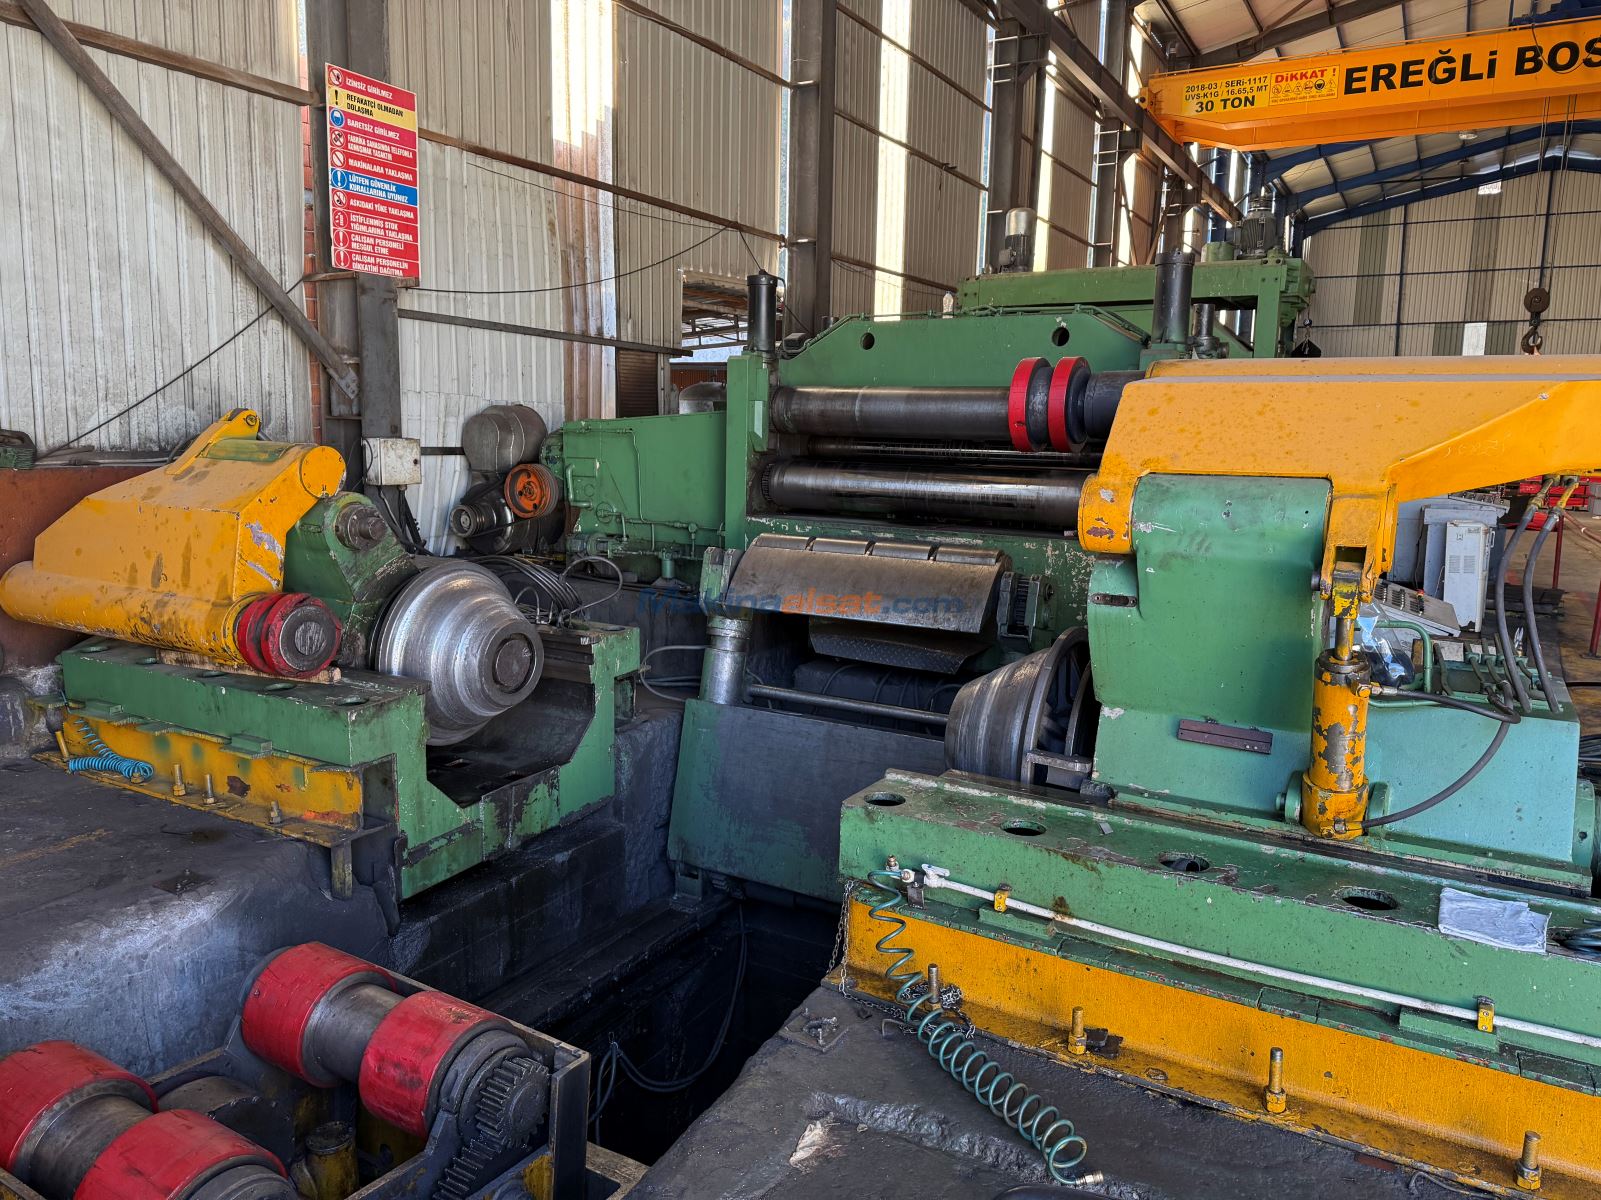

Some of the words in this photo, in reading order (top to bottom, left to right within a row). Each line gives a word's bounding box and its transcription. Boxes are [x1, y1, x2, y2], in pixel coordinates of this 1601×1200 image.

[1185, 83, 1218, 93] 2018-03
[1195, 100, 1214, 112] 30
[1220, 95, 1256, 110] TON
[377, 104, 404, 117] OLMADAN
[347, 118, 373, 132] BARETSİZ
[374, 126, 400, 140] GİRİLMEZ
[349, 174, 369, 186] LÜTFEN
[385, 222, 398, 230] STOK
[375, 245, 389, 254] ETME
